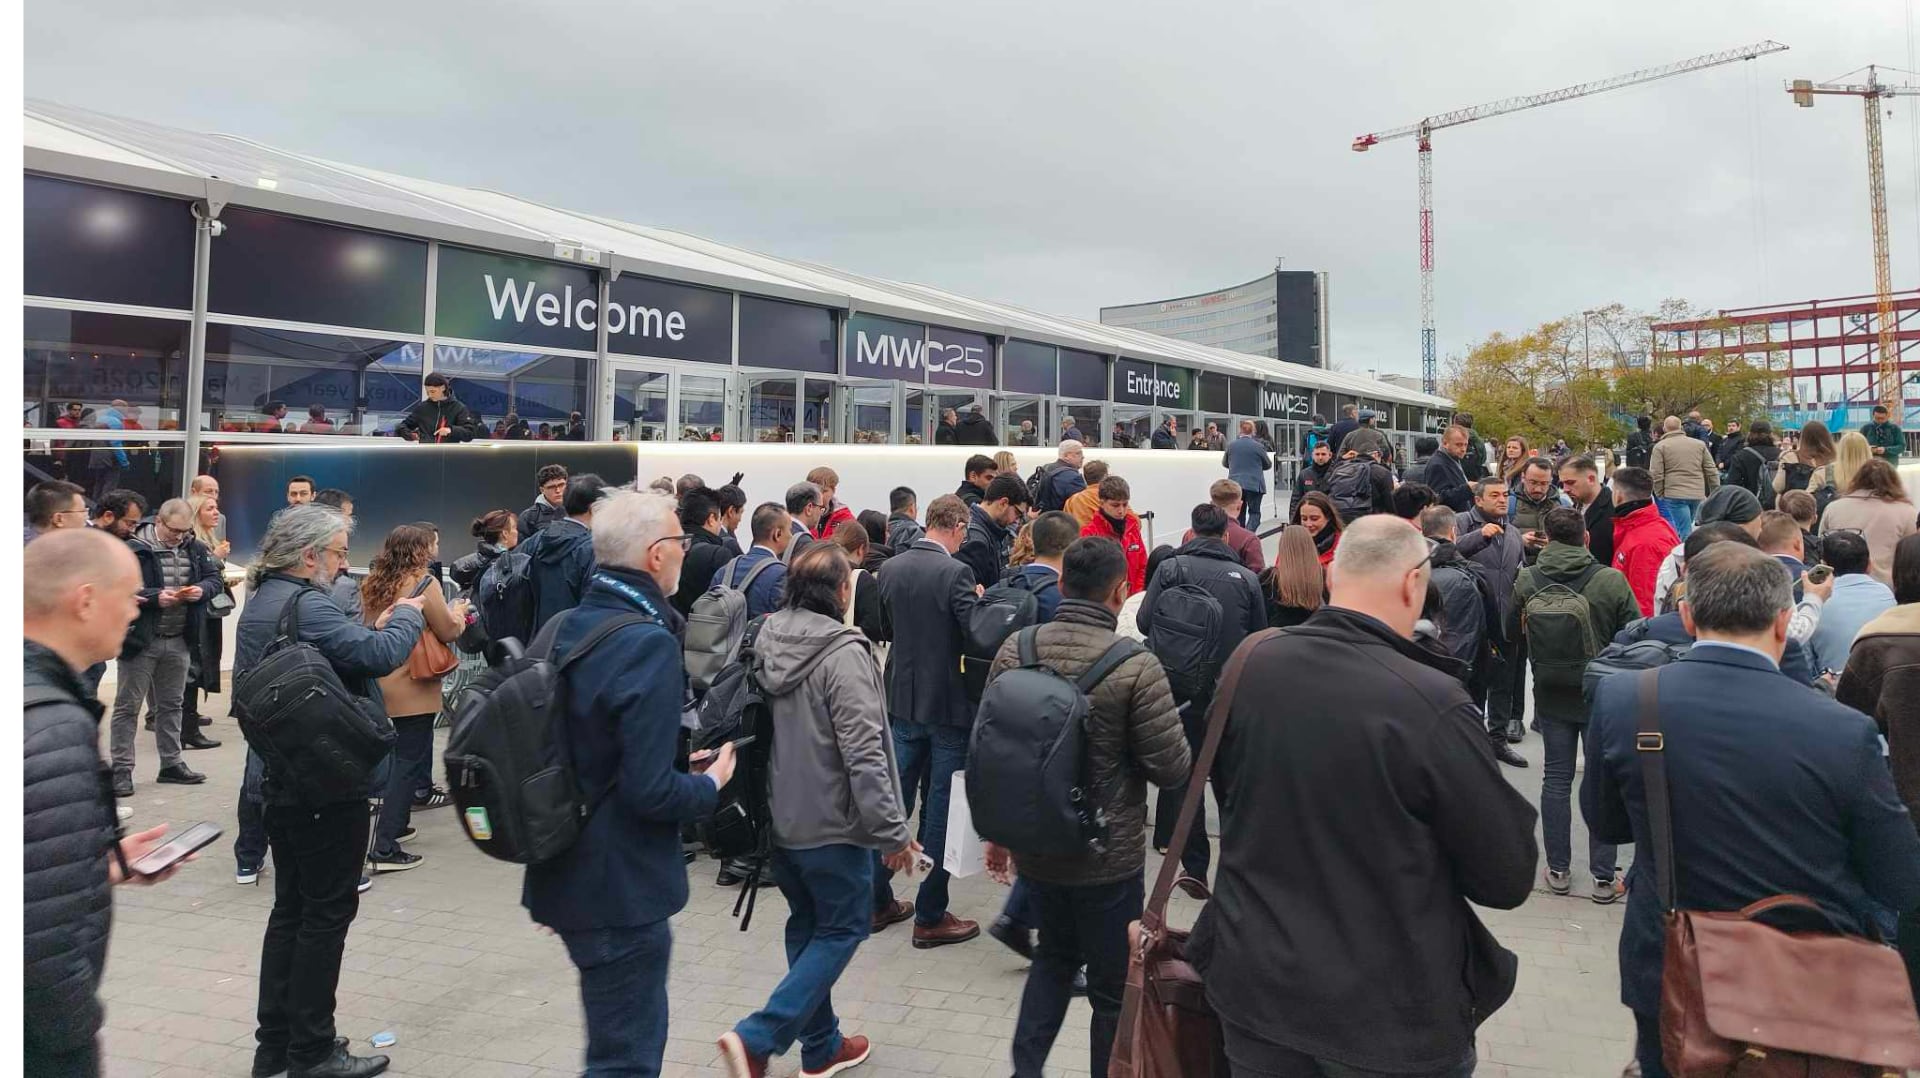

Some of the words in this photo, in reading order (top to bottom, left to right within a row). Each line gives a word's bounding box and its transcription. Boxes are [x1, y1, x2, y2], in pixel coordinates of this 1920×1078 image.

[484, 274, 686, 341] Welcome
[857, 330, 984, 377] MWC25
[1127, 370, 1180, 399] Entrance
[1264, 390, 1309, 415] MWC25
